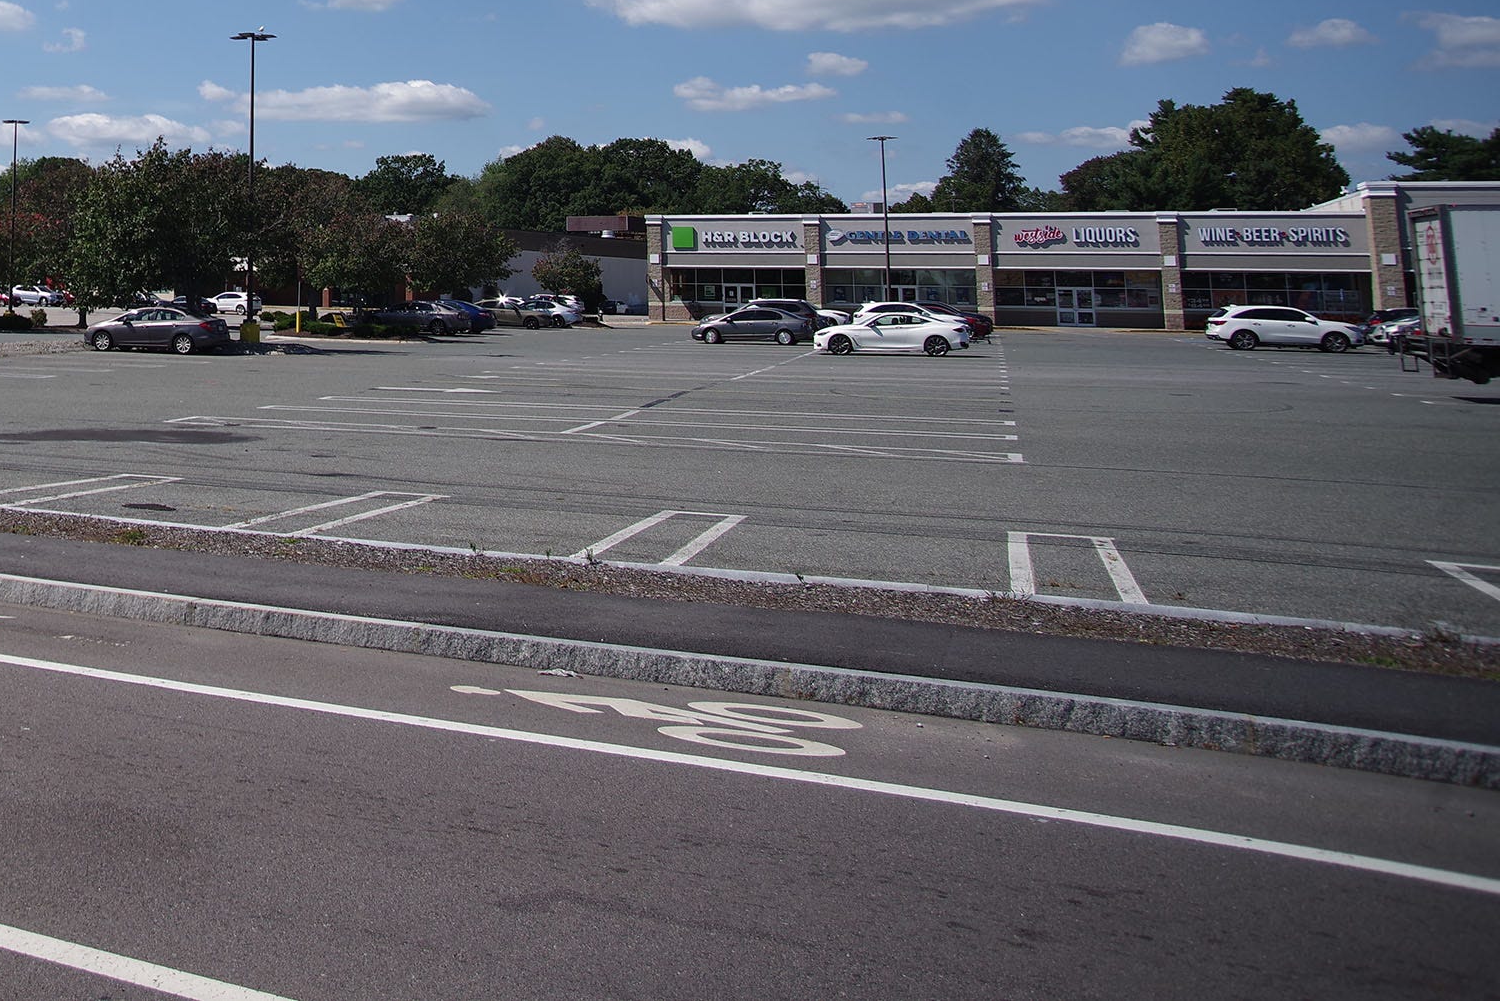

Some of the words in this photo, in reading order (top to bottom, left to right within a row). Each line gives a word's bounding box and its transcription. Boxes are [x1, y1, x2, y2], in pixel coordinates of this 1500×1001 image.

[702, 231, 735, 243] H&R
[739, 231, 793, 243] BLOCK
[907, 230, 967, 240] DENTAL
[1014, 225, 1063, 243] westside
[1072, 227, 1136, 243] LIQUORS
[1198, 227, 1235, 242] WINE
[1243, 227, 1280, 242] BEER
[1288, 227, 1346, 242] SPIRITS
